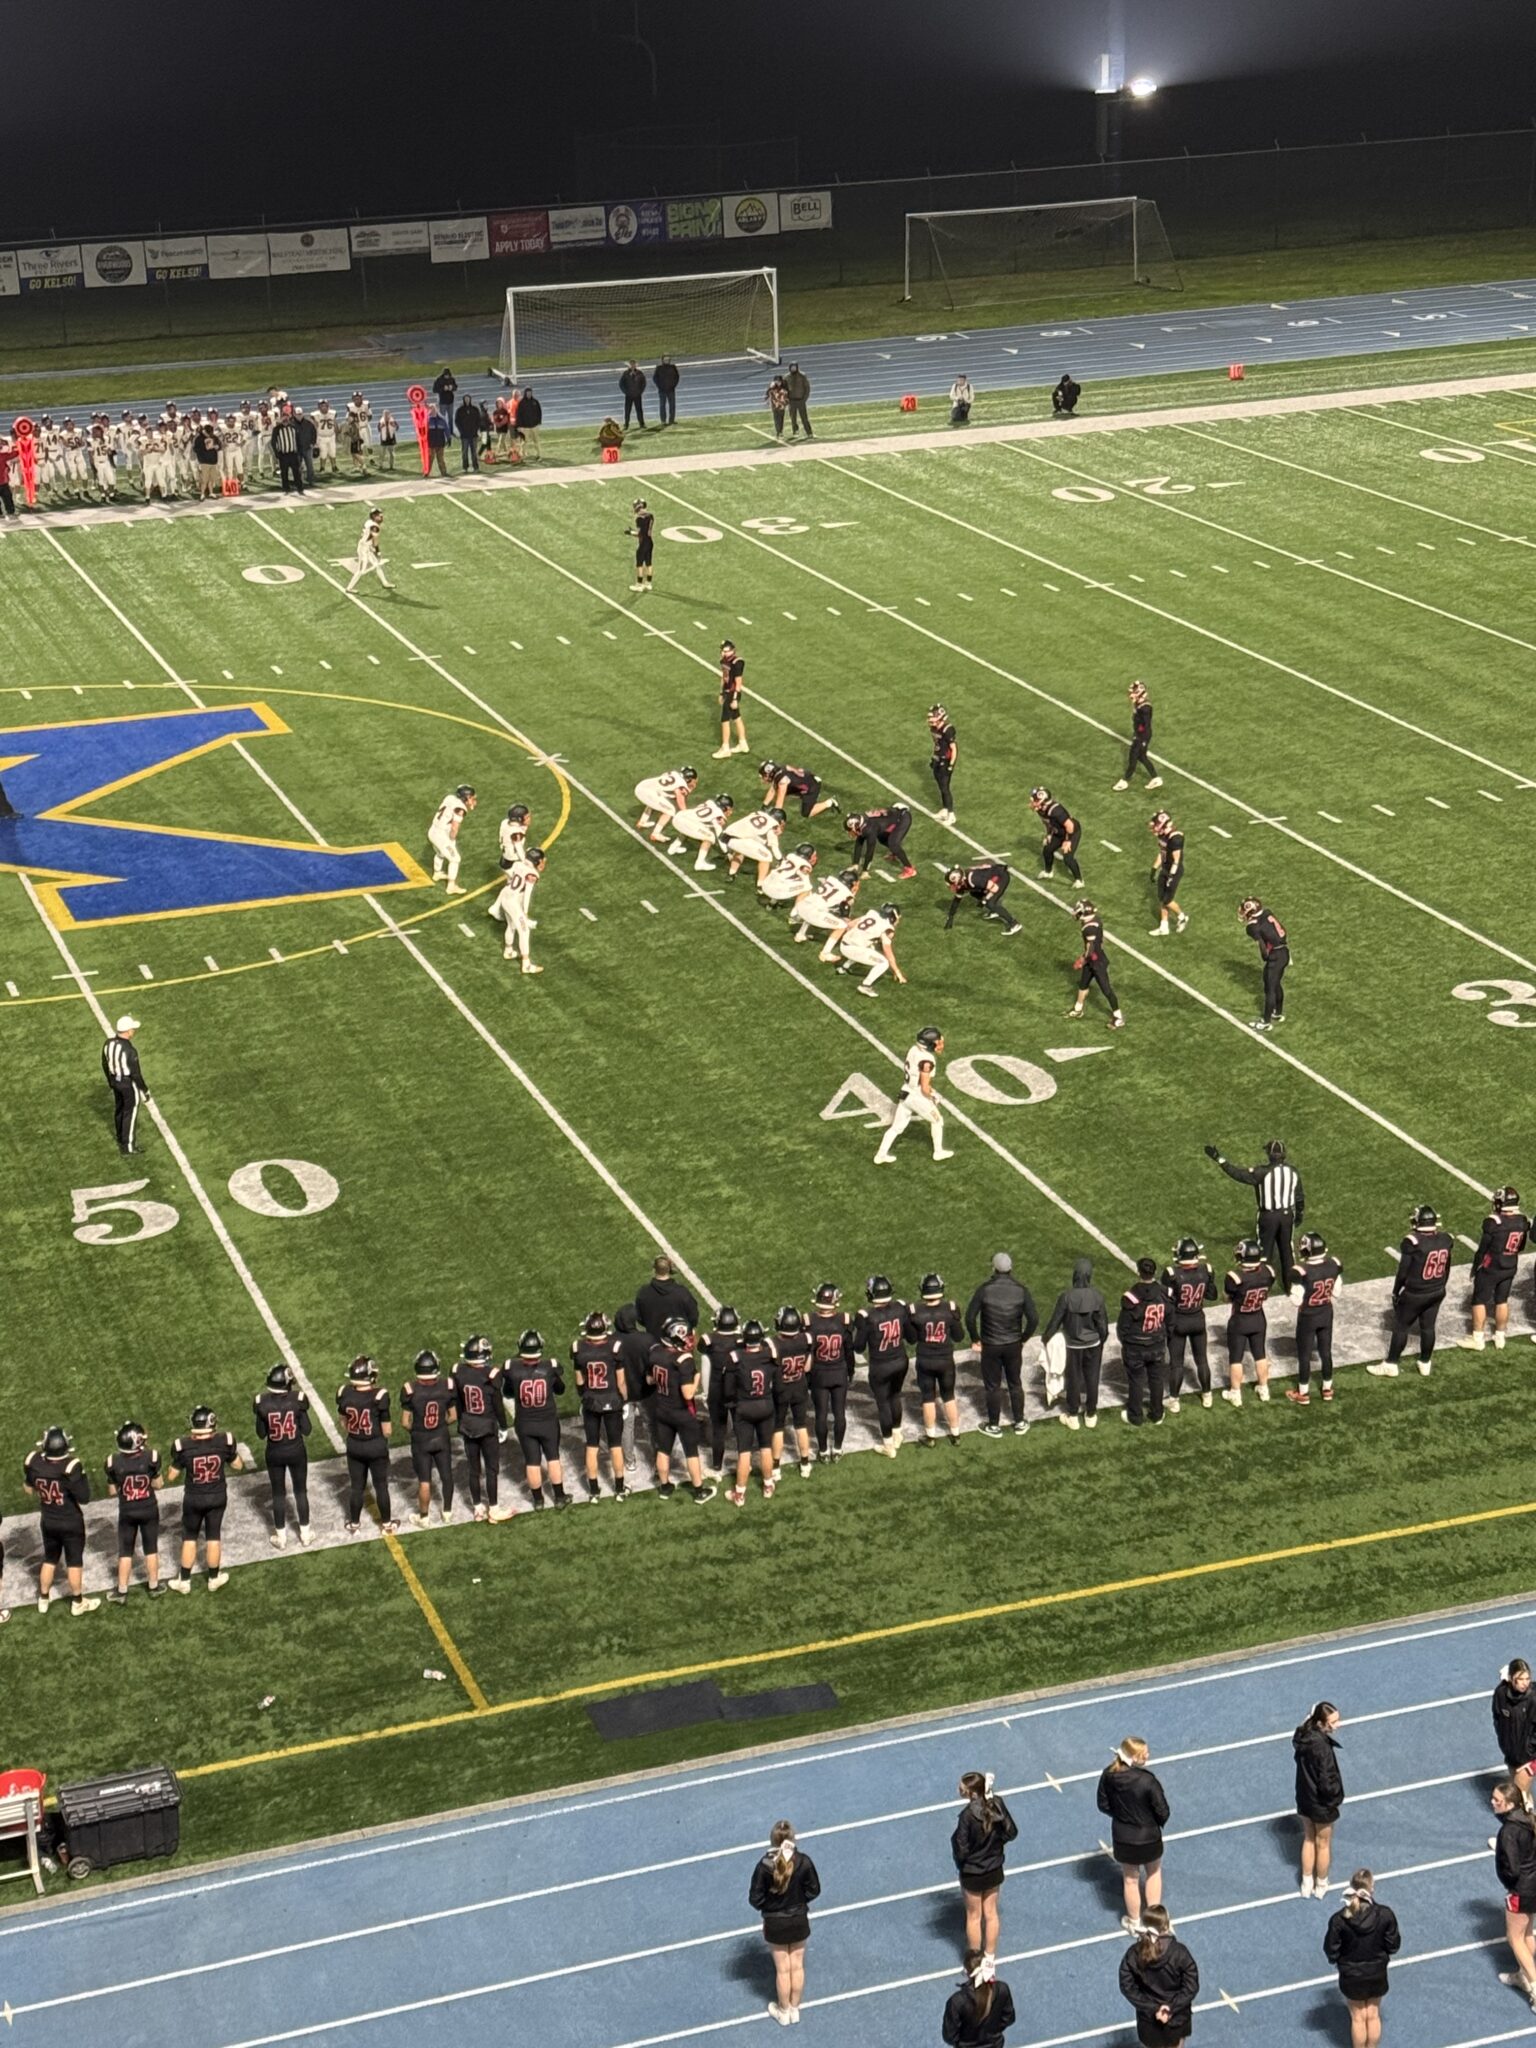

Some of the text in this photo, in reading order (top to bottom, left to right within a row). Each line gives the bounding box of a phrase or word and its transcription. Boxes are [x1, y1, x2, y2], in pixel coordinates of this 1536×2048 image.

[793, 202, 820, 215] BELL
[495, 240, 519, 253] APPLY
[521, 237, 546, 251] TODAY
[22, 258, 79, 272] Three Rivers
[156, 269, 168, 280] GO
[29, 276, 77, 289] GO KELSO!
[904, 397, 917, 411] 20
[319, 419, 333, 430] 76
[46, 434, 58, 446] 14
[224, 432, 239, 444] 22
[95, 444, 108, 457] 15
[225, 482, 238, 494] 40
[816, 880, 840, 903] 51
[857, 917, 877, 931] 8
[1422, 1249, 1449, 1281] 68
[1177, 1283, 1206, 1309] 34
[879, 1318, 901, 1352] 74
[925, 1321, 946, 1343] 14
[816, 1334, 843, 1362] 20
[586, 1361, 609, 1389] 12
[750, 1369, 765, 1397] 3
[463, 1384, 485, 1415] 13
[519, 1378, 547, 1408] 60
[267, 1410, 297, 1441] 54
[345, 1407, 373, 1435] 24
[424, 1401, 439, 1429] 8
[192, 1453, 222, 1484] 52
[122, 1474, 150, 1502] 42
